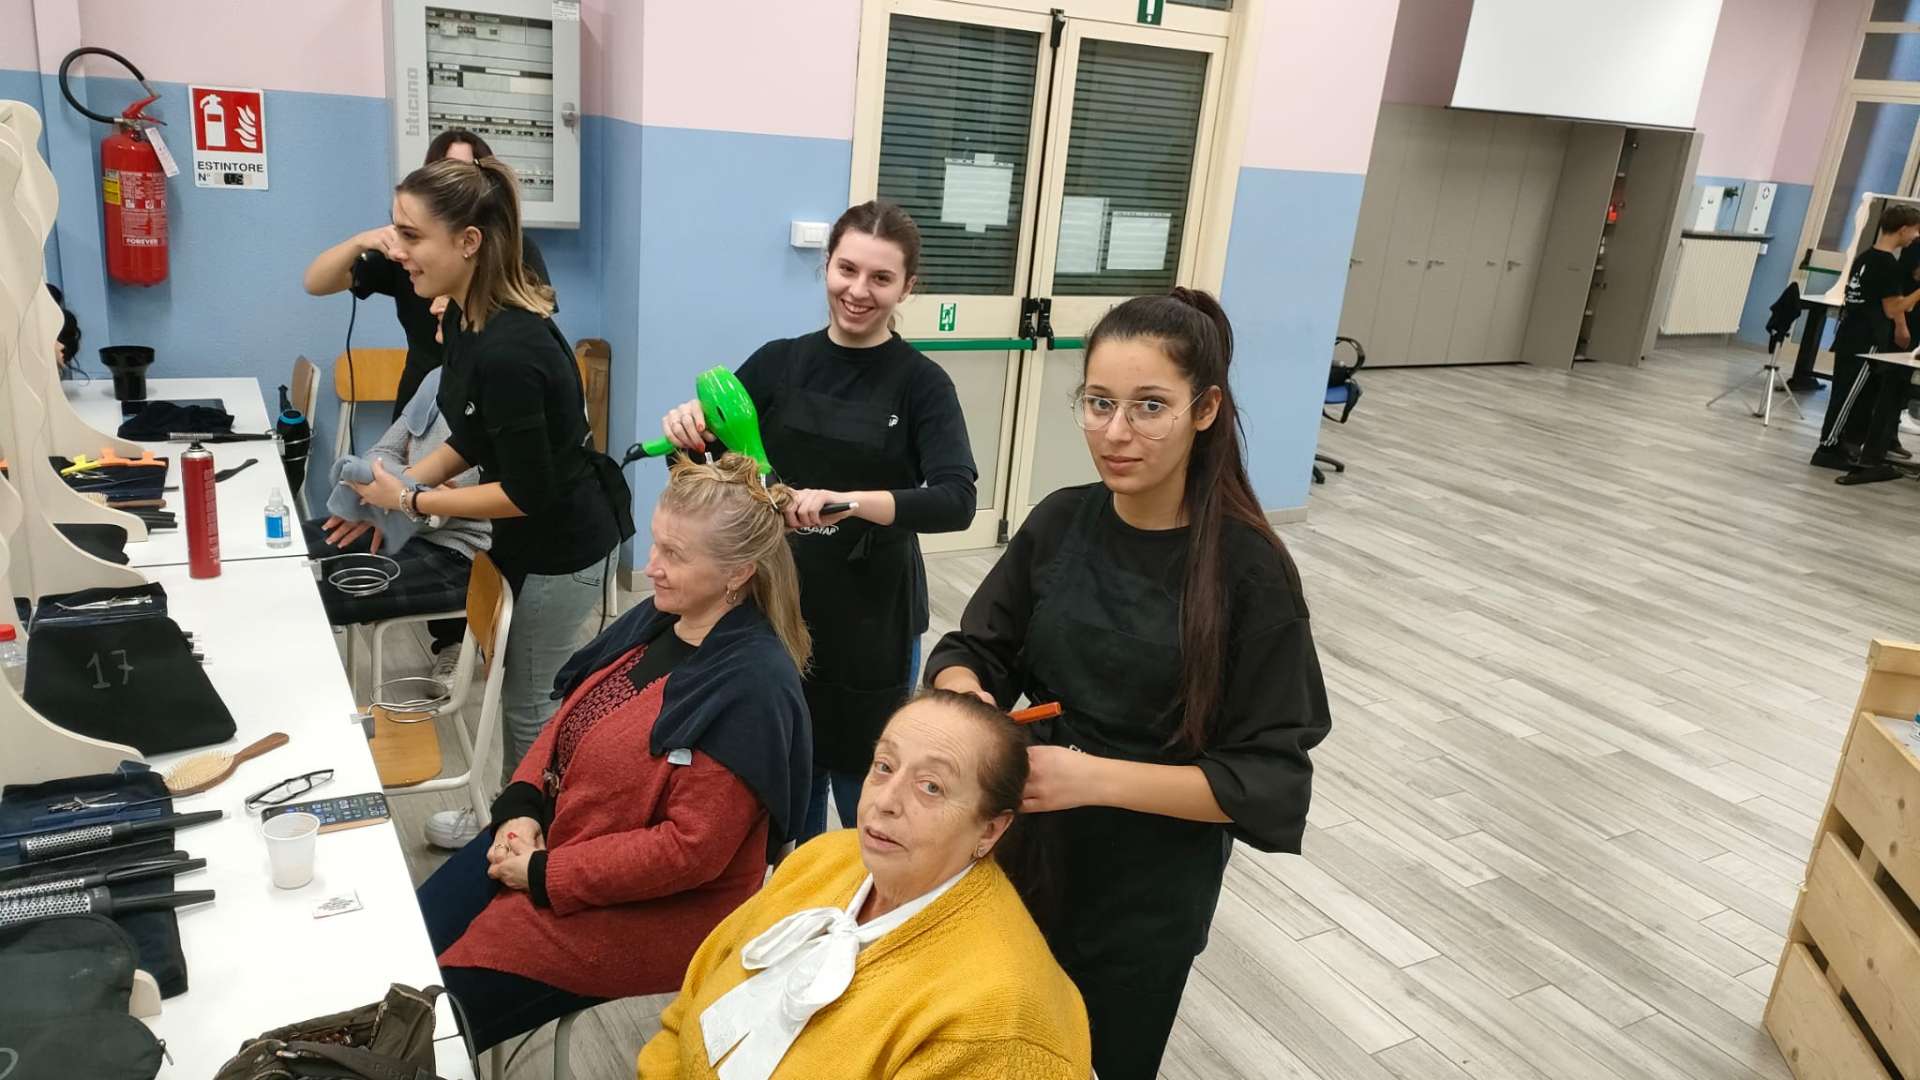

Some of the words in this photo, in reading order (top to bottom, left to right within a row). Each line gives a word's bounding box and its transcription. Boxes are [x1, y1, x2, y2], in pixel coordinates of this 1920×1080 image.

[406, 67, 420, 136] bticino
[197, 161, 264, 172] ESTINTORE
[126, 238, 159, 247] FOREVER
[86, 649, 134, 689] 17
